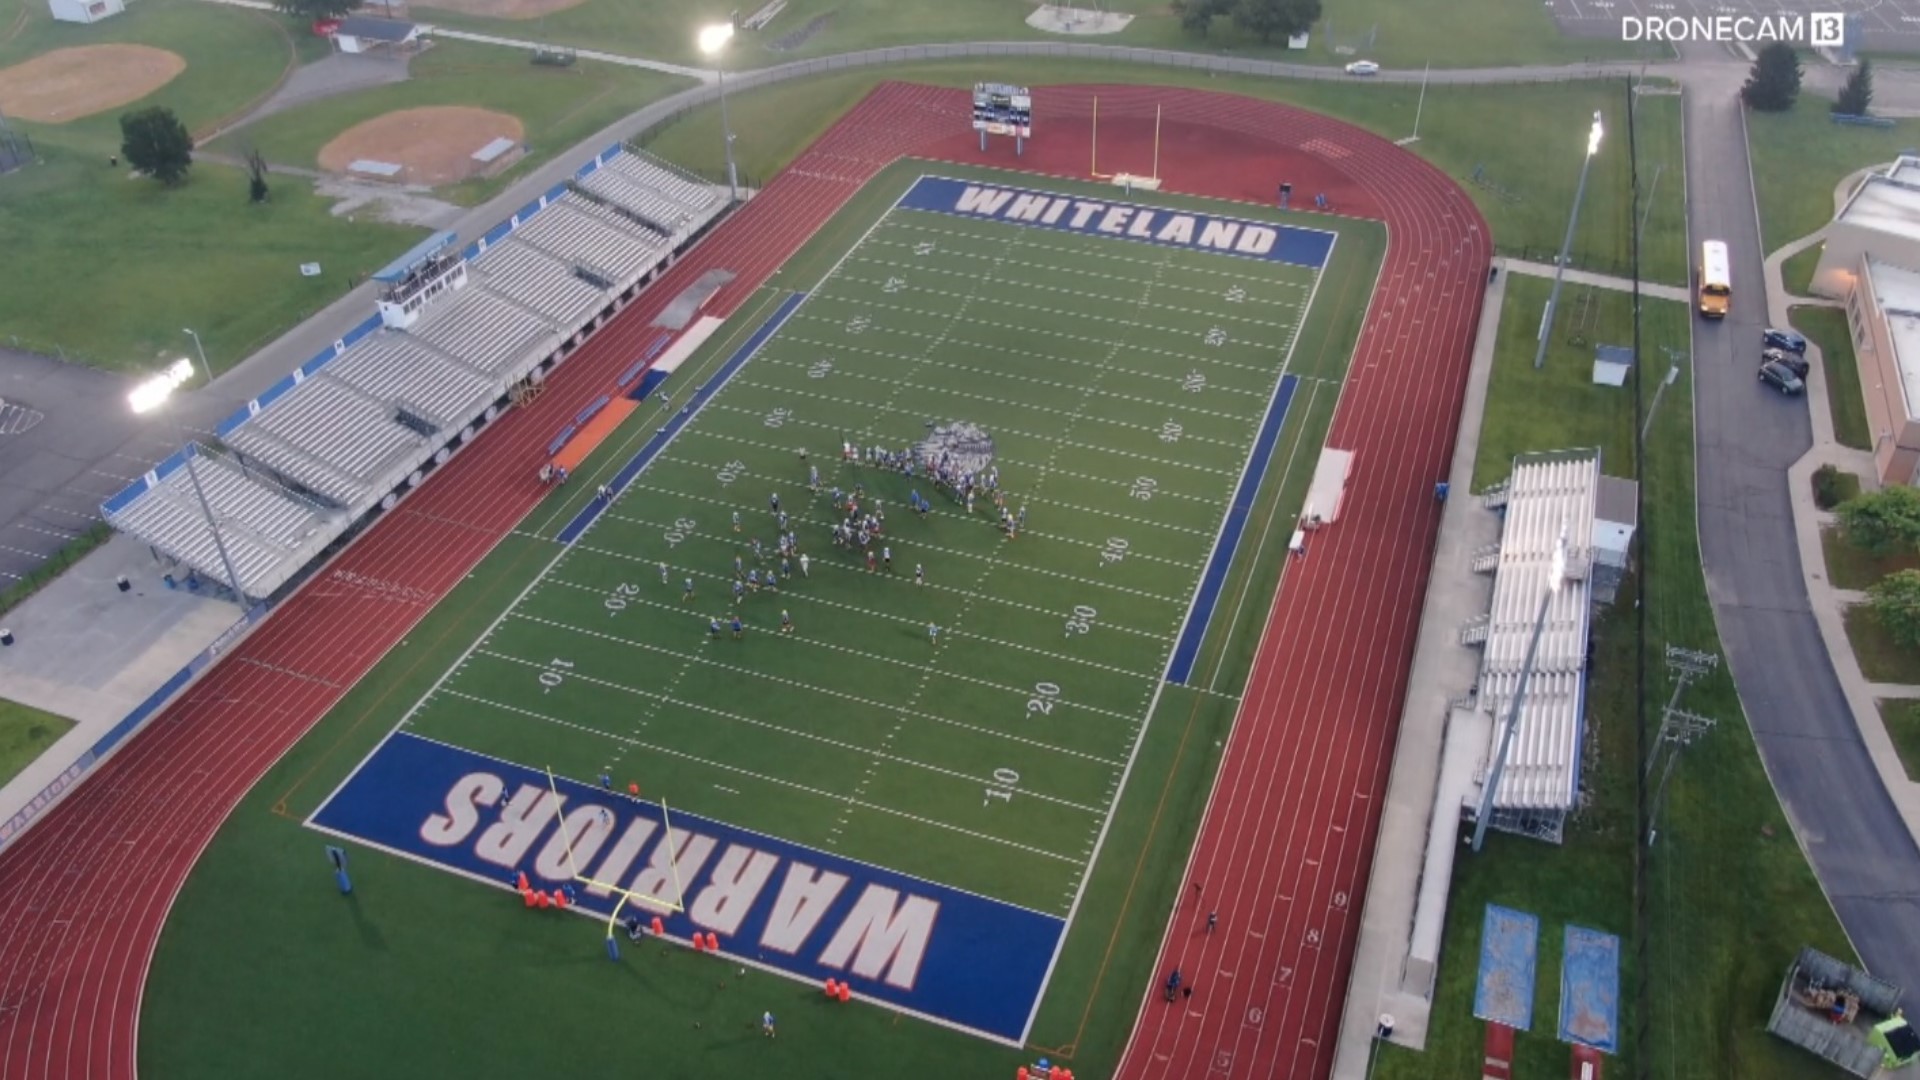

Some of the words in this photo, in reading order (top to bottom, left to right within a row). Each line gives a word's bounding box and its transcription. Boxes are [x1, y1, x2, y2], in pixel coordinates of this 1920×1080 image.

[955, 185, 1277, 255] WHITELAND
[664, 518, 695, 542] 30
[605, 583, 639, 609] 20
[1066, 605, 1096, 634] 30
[538, 658, 574, 686] 10
[1027, 683, 1060, 715] 20
[986, 768, 1019, 803] 10
[418, 771, 941, 991] WARRIORS
[1307, 928, 1319, 943] 8
[1279, 966, 1292, 982] 7
[1248, 1007, 1262, 1023] 6
[1217, 1050, 1231, 1067] 5
